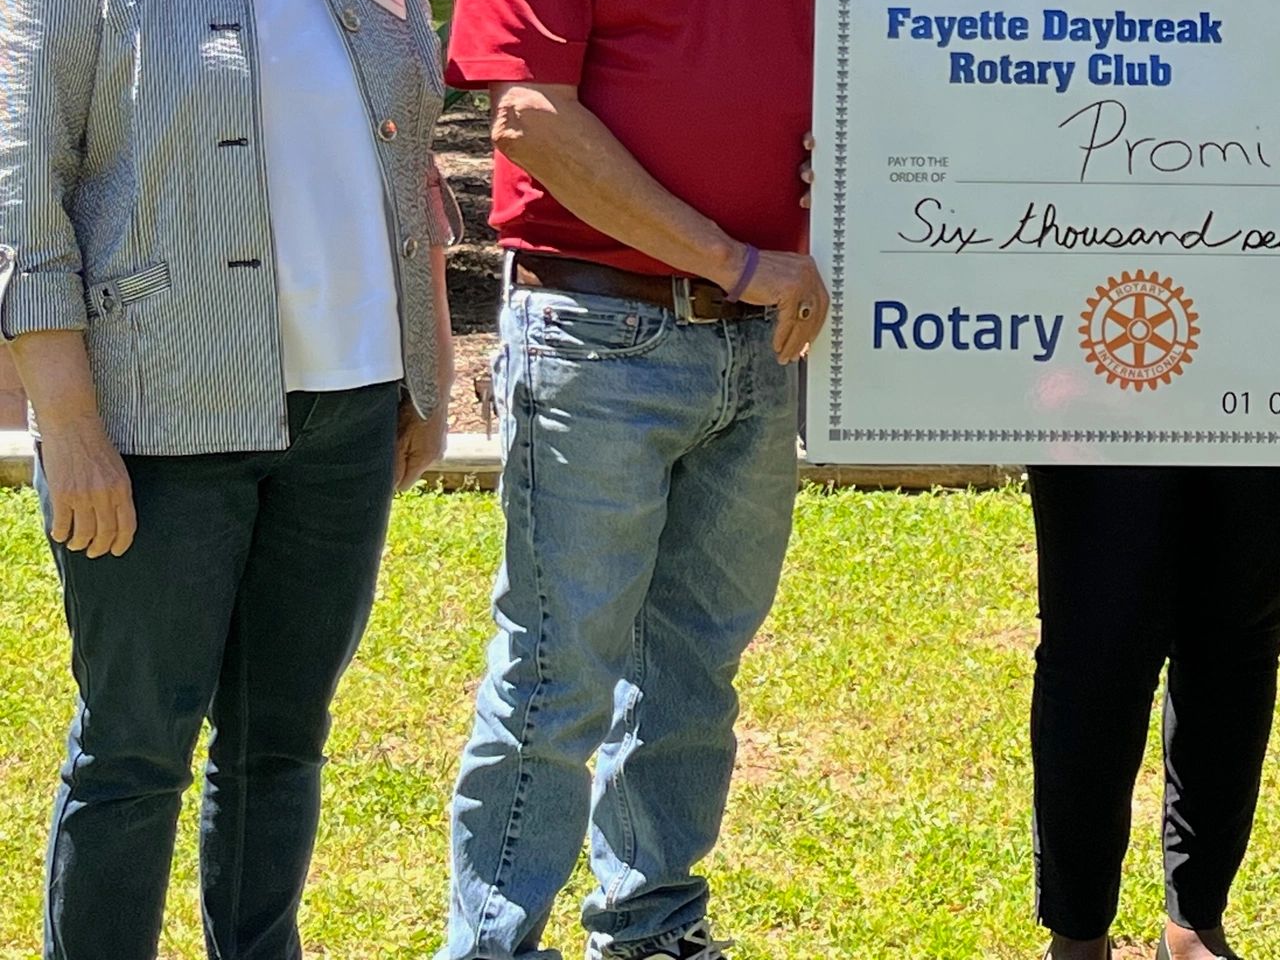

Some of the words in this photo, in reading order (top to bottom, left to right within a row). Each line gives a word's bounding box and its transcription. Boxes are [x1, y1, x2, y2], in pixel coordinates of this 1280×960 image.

[887, 7, 1030, 47] Fayette
[1043, 10, 1223, 50] Daybreak
[949, 52, 1075, 93] Rotary
[1088, 55, 1172, 87] Club
[887, 156, 908, 167] PAY
[910, 156, 926, 167] TO
[927, 156, 949, 167] THE
[889, 172, 929, 183] ORDER
[930, 172, 947, 183] OF
[898, 197, 994, 254] Six
[999, 201, 1243, 251] thousand
[1114, 282, 1165, 298] ROTARY
[872, 300, 1065, 363] Rotary
[1097, 348, 1181, 379] INTERNATIONAL
[1221, 391, 1252, 415] 01
